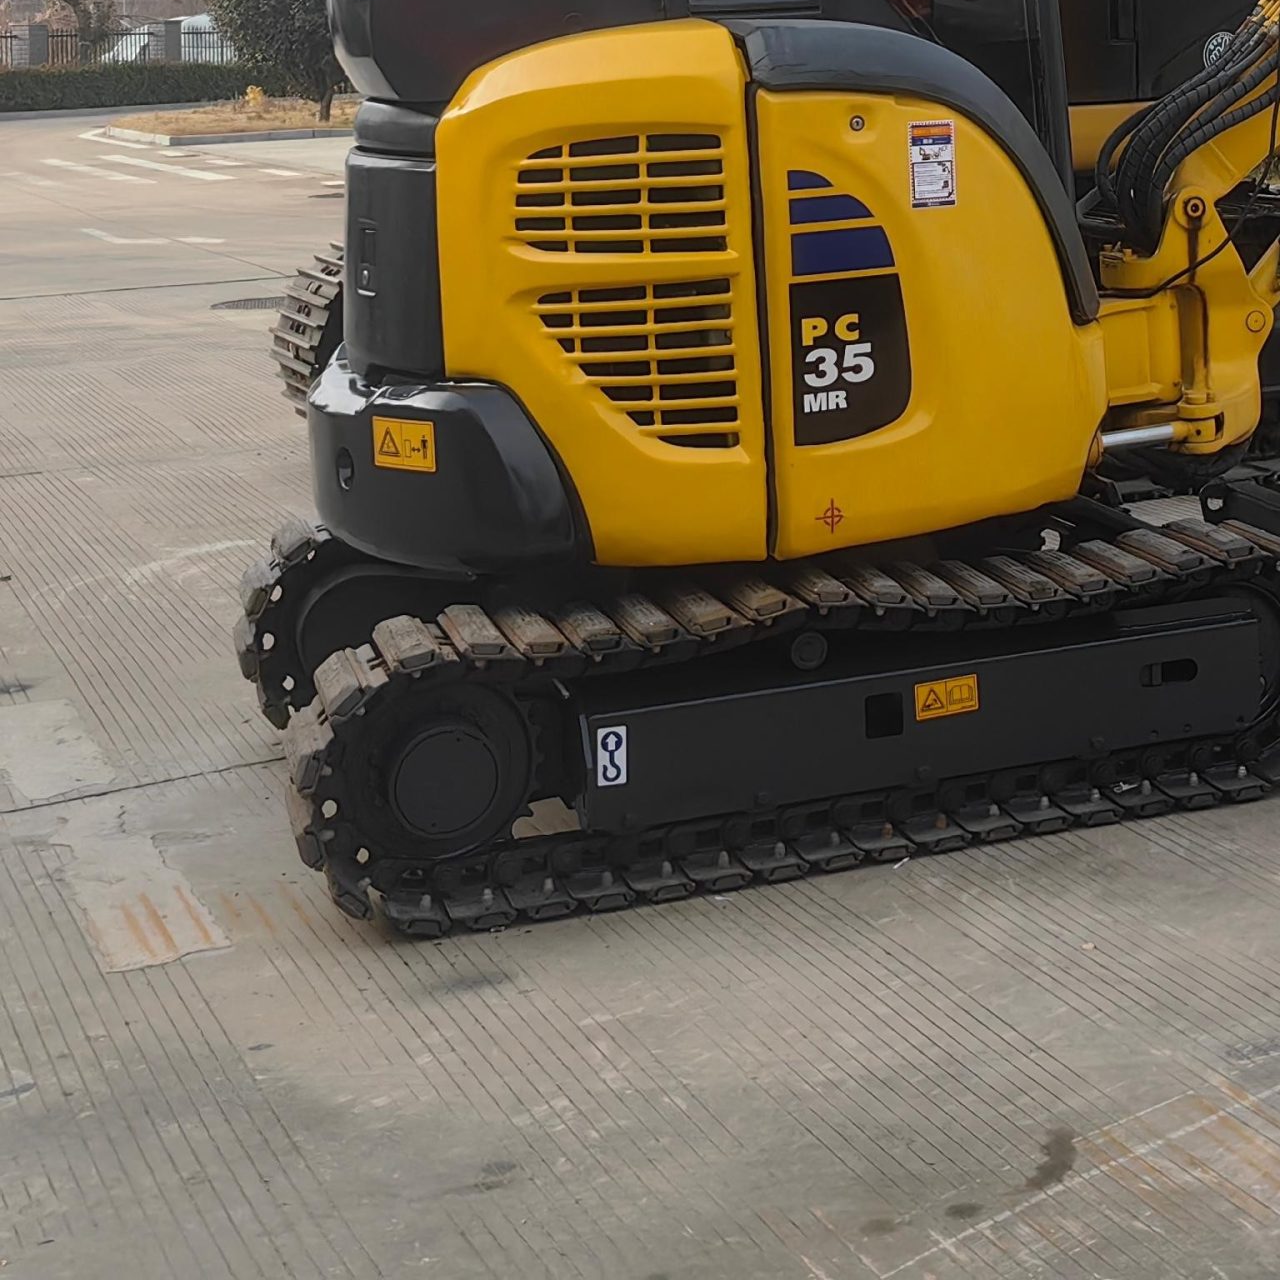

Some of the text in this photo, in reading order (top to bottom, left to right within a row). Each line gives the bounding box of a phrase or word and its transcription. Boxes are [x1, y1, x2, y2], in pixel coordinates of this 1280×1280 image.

[801, 313, 860, 347] PC
[803, 342, 875, 388] 35
[803, 390, 848, 414] MR
